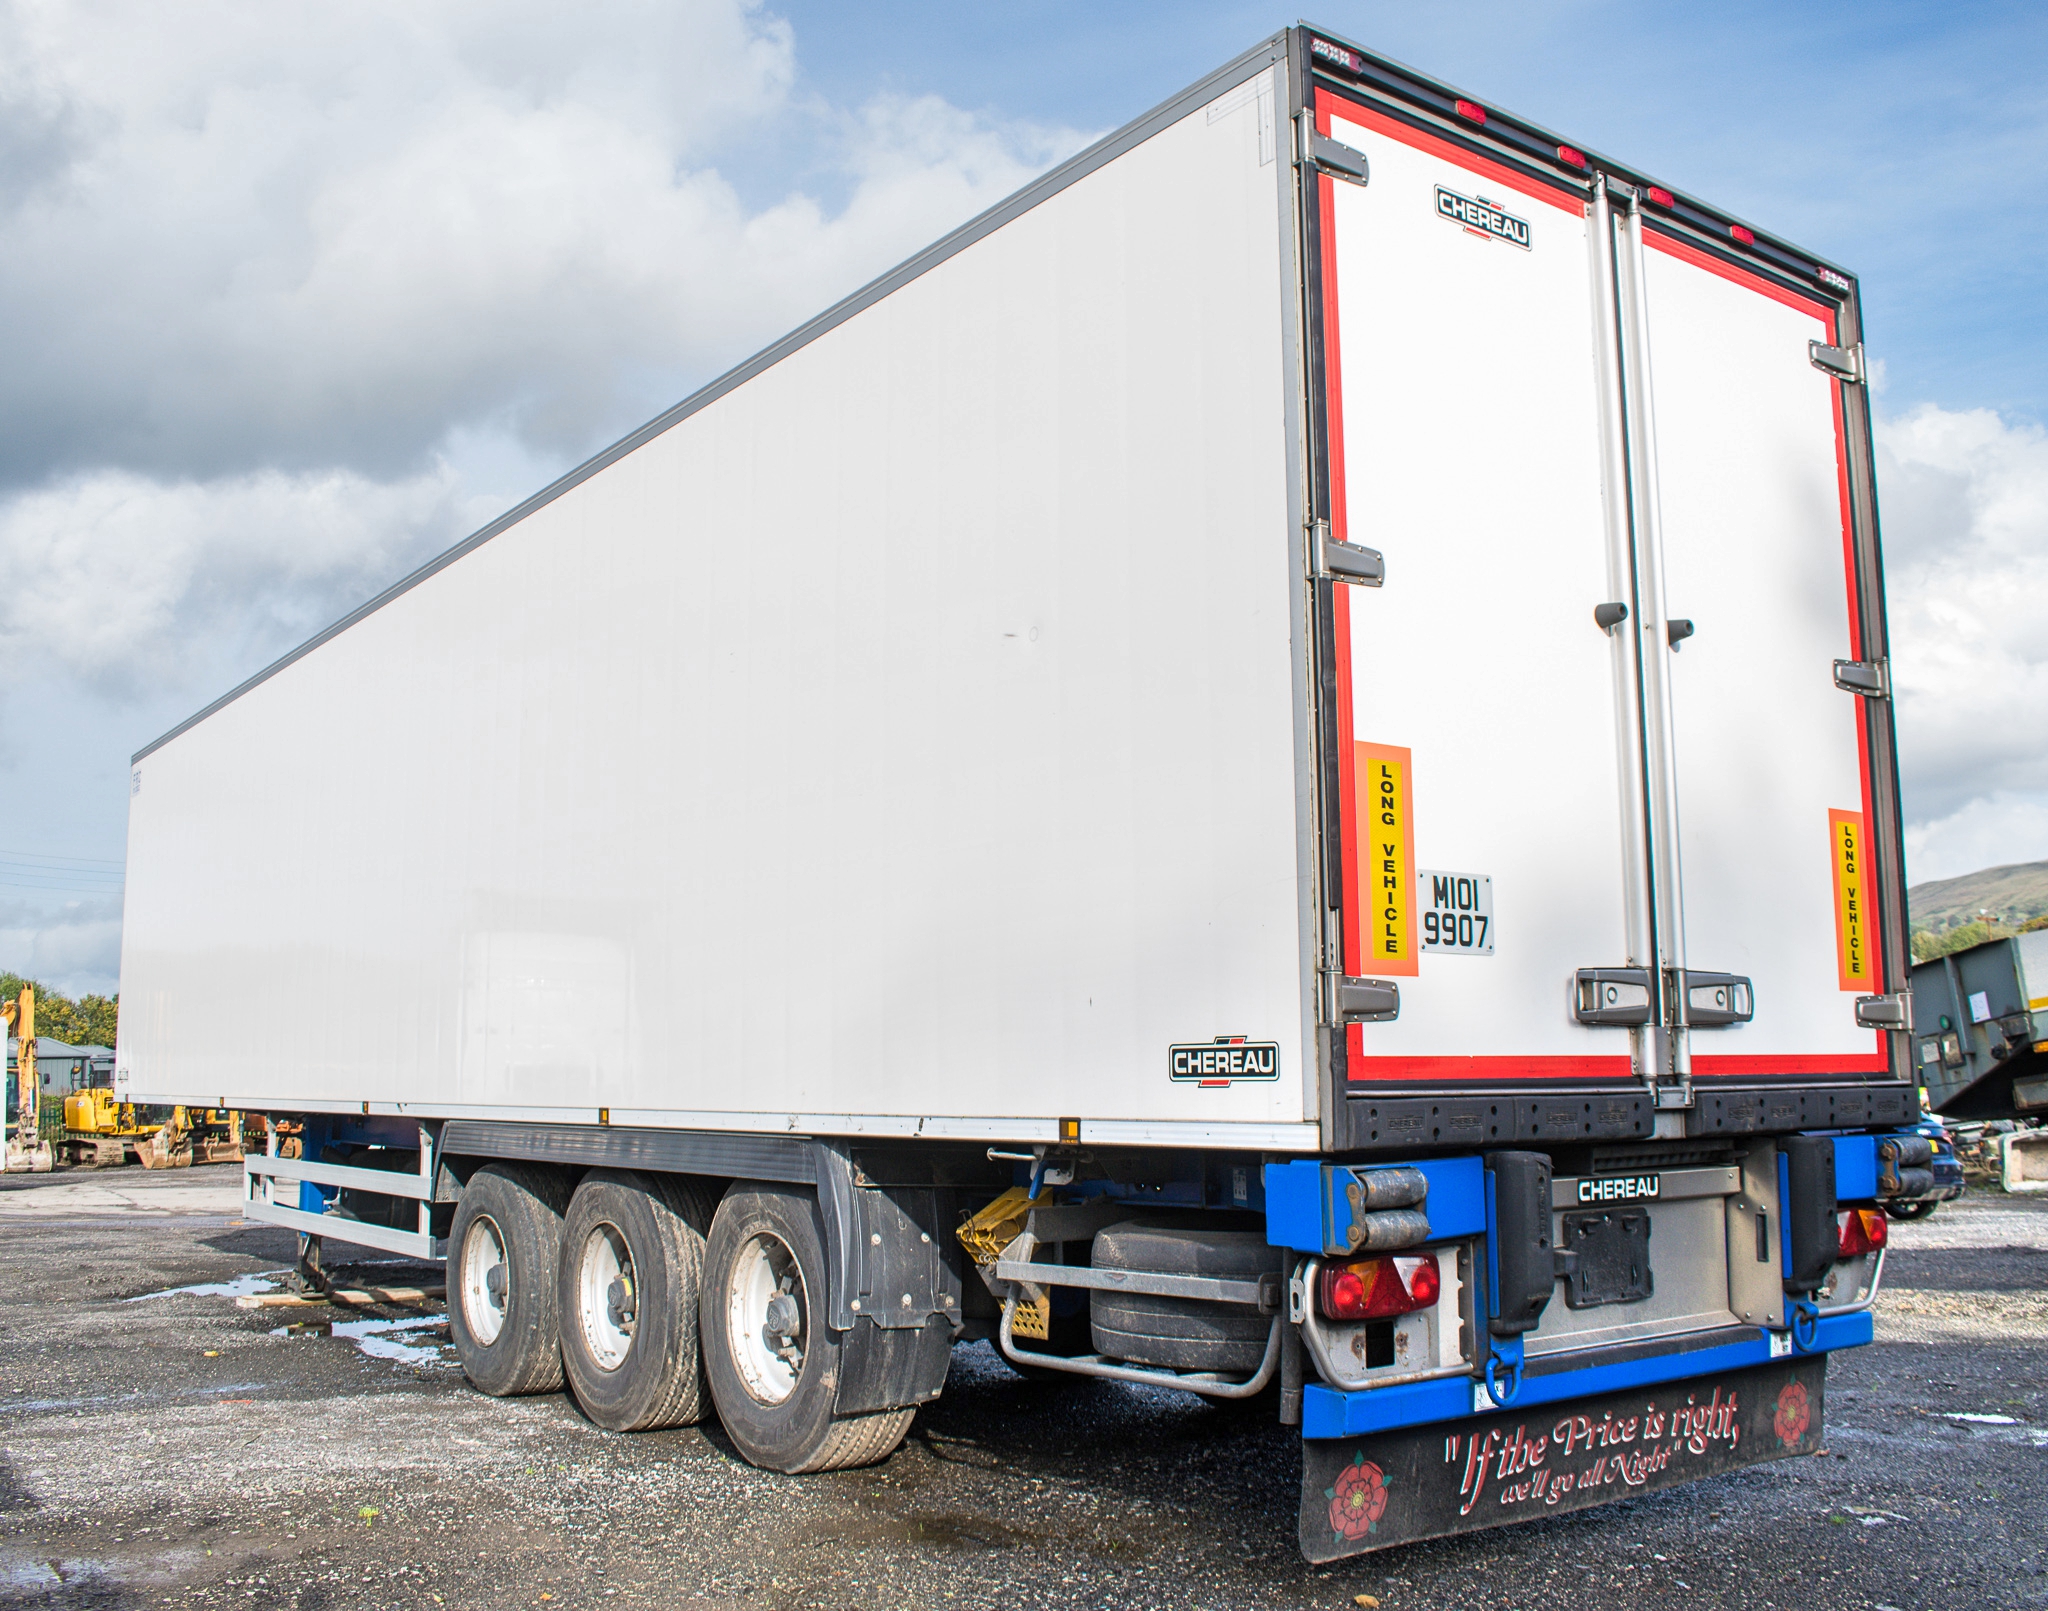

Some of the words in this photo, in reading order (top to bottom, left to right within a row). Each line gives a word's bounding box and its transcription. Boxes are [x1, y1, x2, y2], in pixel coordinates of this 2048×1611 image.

[1438, 192, 1529, 244] CHEREAU
[1380, 764, 1395, 826] LONG
[1844, 826, 1855, 873] LONG
[1383, 843, 1398, 953] VEHICLE
[1424, 911, 1489, 948] 9907
[1847, 887, 1860, 973] VEHICLE
[1174, 1049, 1274, 1074] CHEREAU
[1578, 1176, 1659, 1202] CHEREAU
[1496, 1424, 1549, 1480] the
[1553, 1410, 1639, 1456] Price
[1643, 1402, 1666, 1440] is
[1670, 1385, 1740, 1455] right,
[1500, 1468, 1551, 1505] we'll
[1545, 1472, 1576, 1505] go
[1577, 1457, 1607, 1490] all
